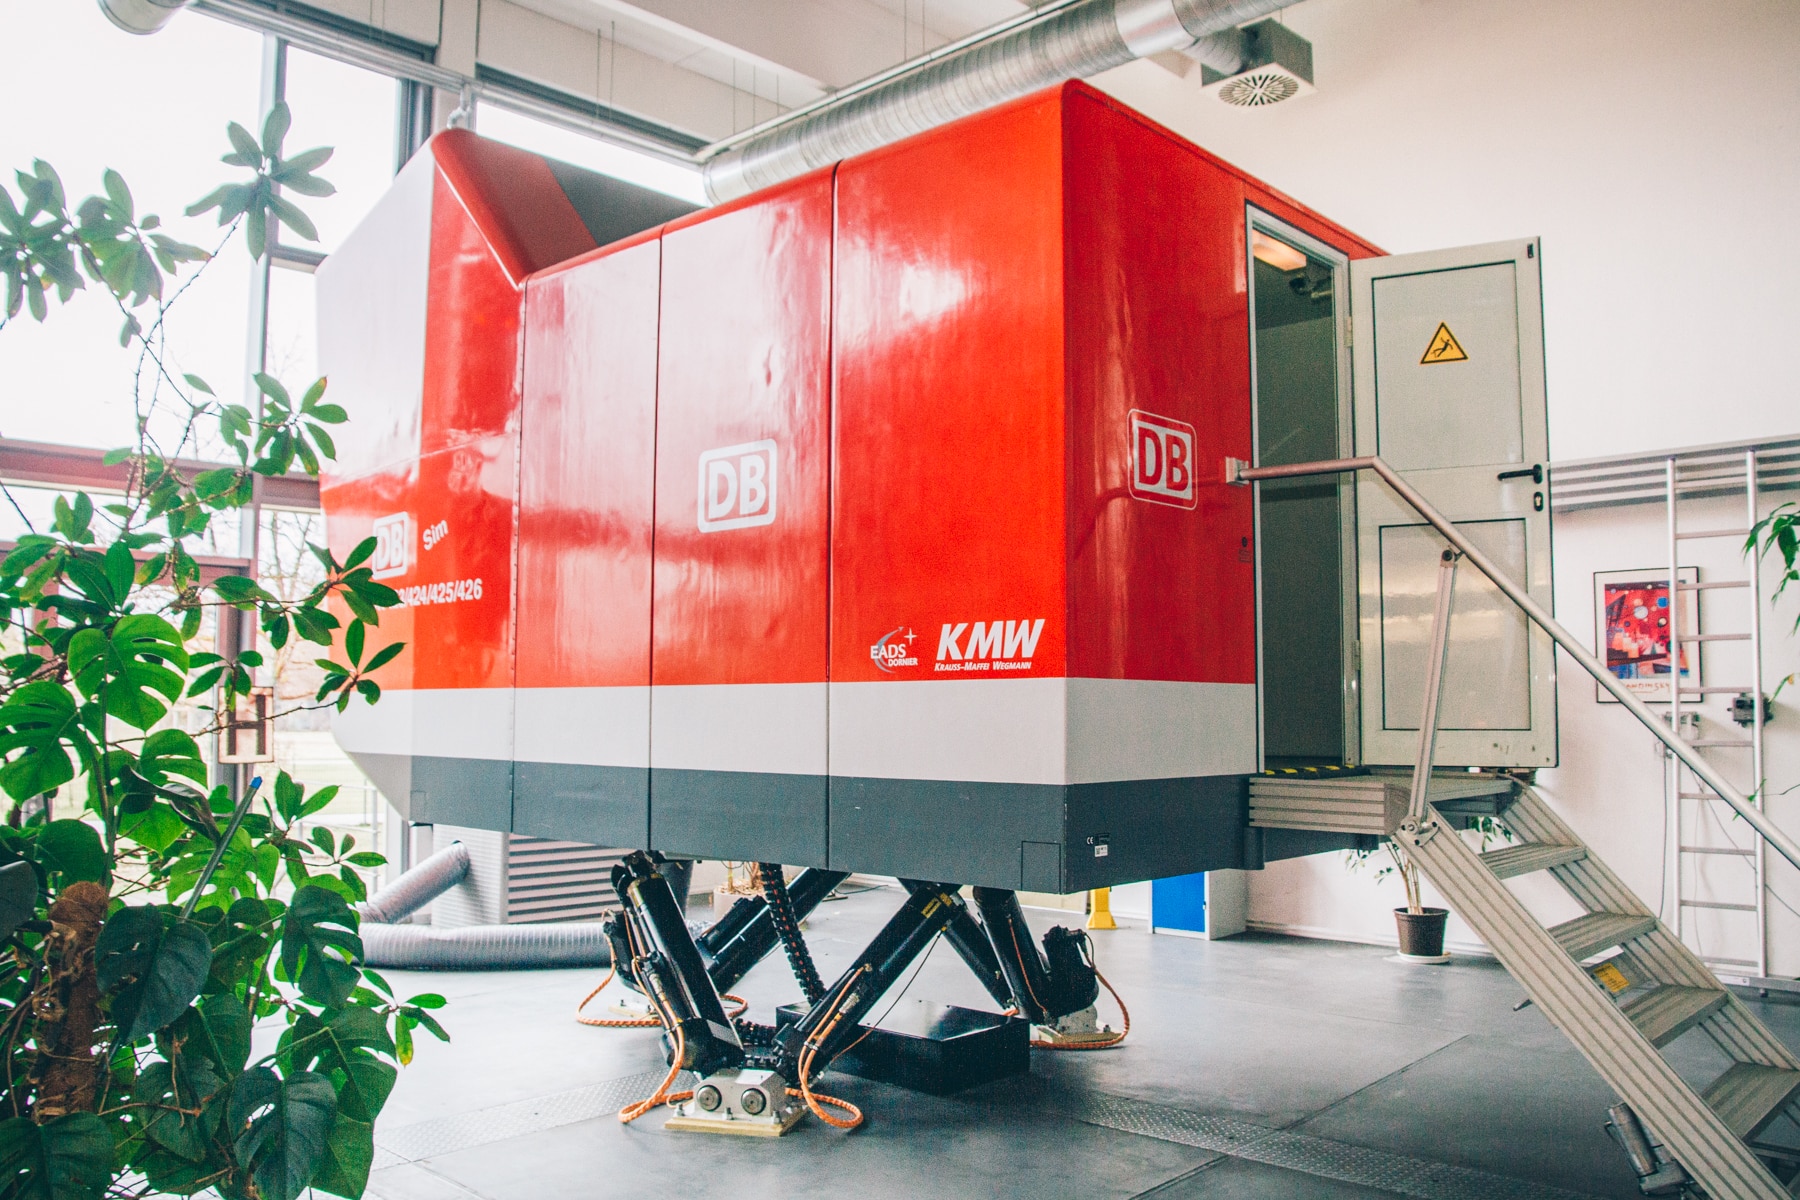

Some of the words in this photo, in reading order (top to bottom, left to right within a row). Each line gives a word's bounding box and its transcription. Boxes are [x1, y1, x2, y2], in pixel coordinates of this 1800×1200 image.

[1137, 425, 1190, 493] DB
[707, 453, 767, 520] DB
[376, 522, 404, 570] DB
[422, 519, 449, 551] Sim
[388, 577, 483, 610] 3/424/425/426
[870, 643, 907, 660] EADS
[936, 618, 1046, 661] KMW
[887, 657, 919, 667] DORNIER
[1624, 682, 1671, 694] ANDINSKY
[226, 693, 267, 756] H
